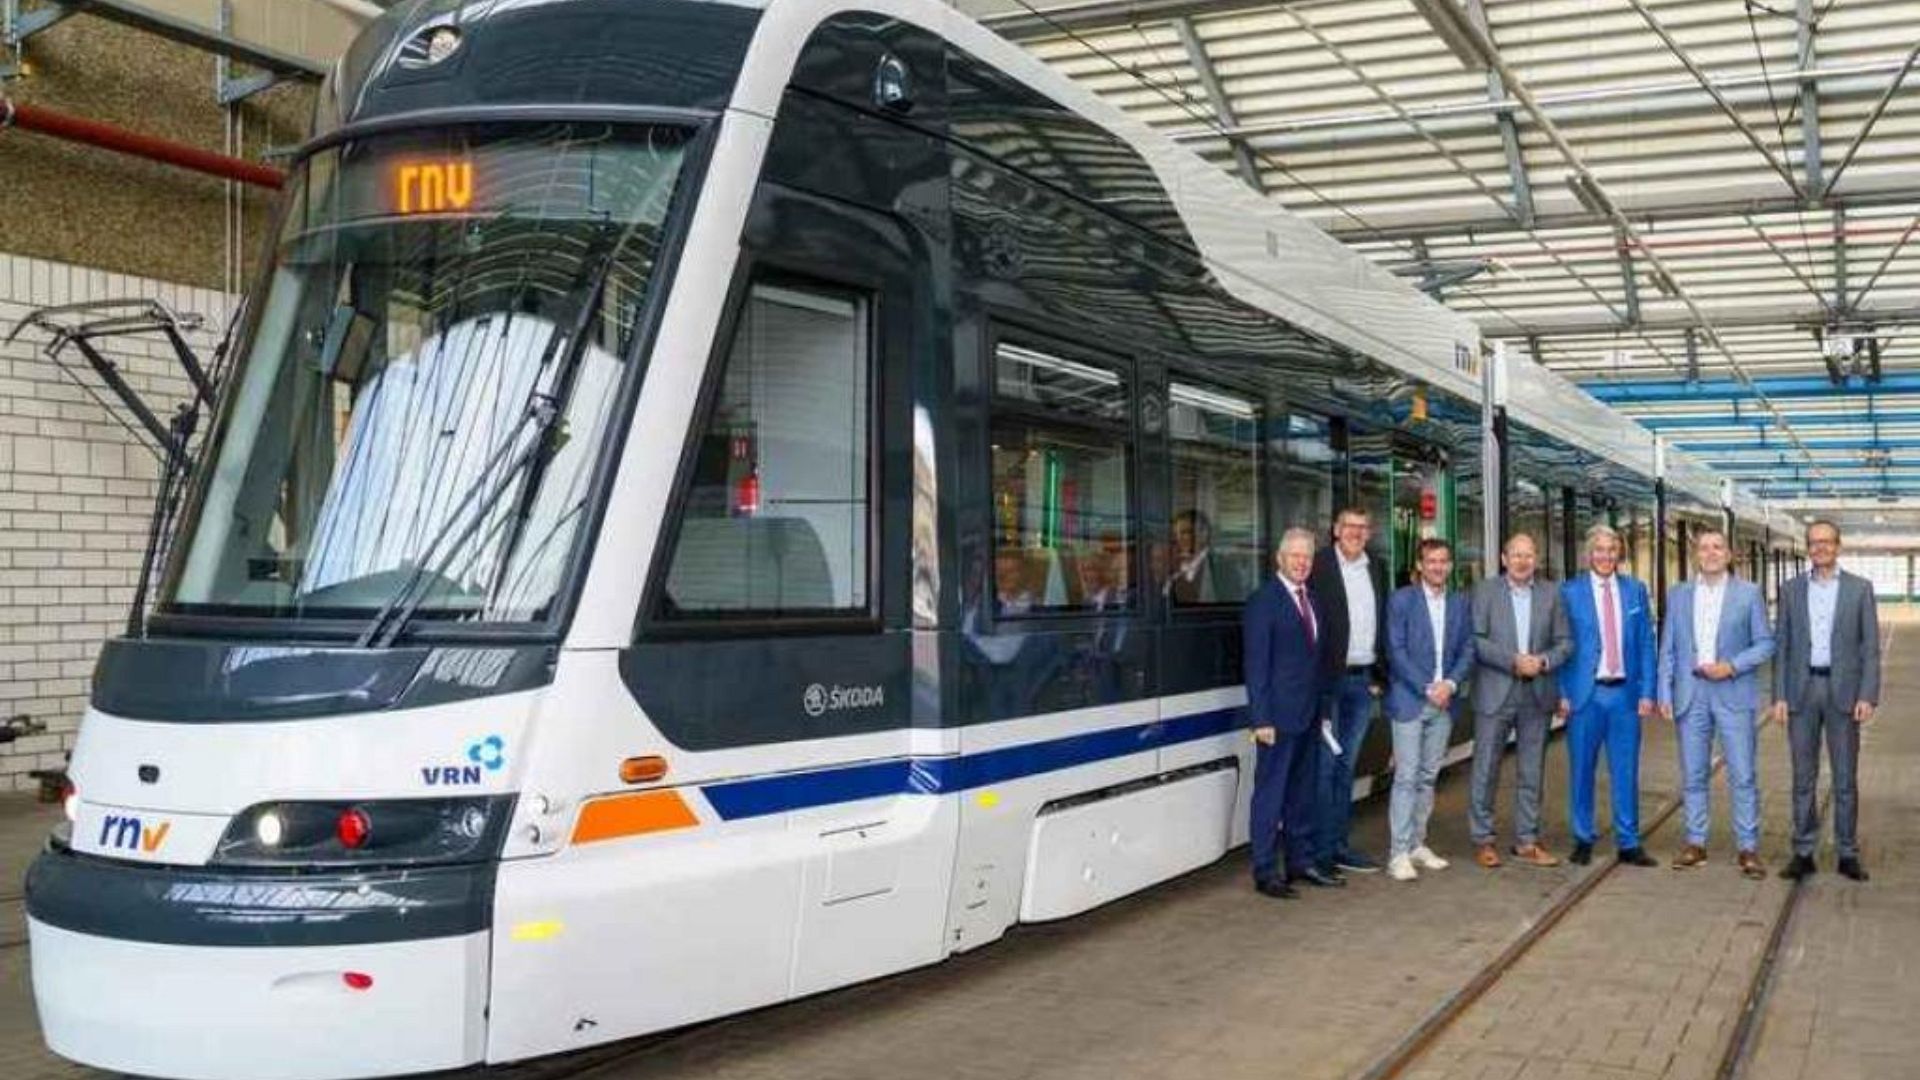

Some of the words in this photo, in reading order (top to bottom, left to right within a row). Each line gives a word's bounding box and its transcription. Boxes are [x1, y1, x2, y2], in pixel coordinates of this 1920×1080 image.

[399, 162, 472, 213] rnv
[829, 684, 884, 710] ŠKODA
[421, 766, 481, 785] VRN
[99, 814, 171, 852] rnv
